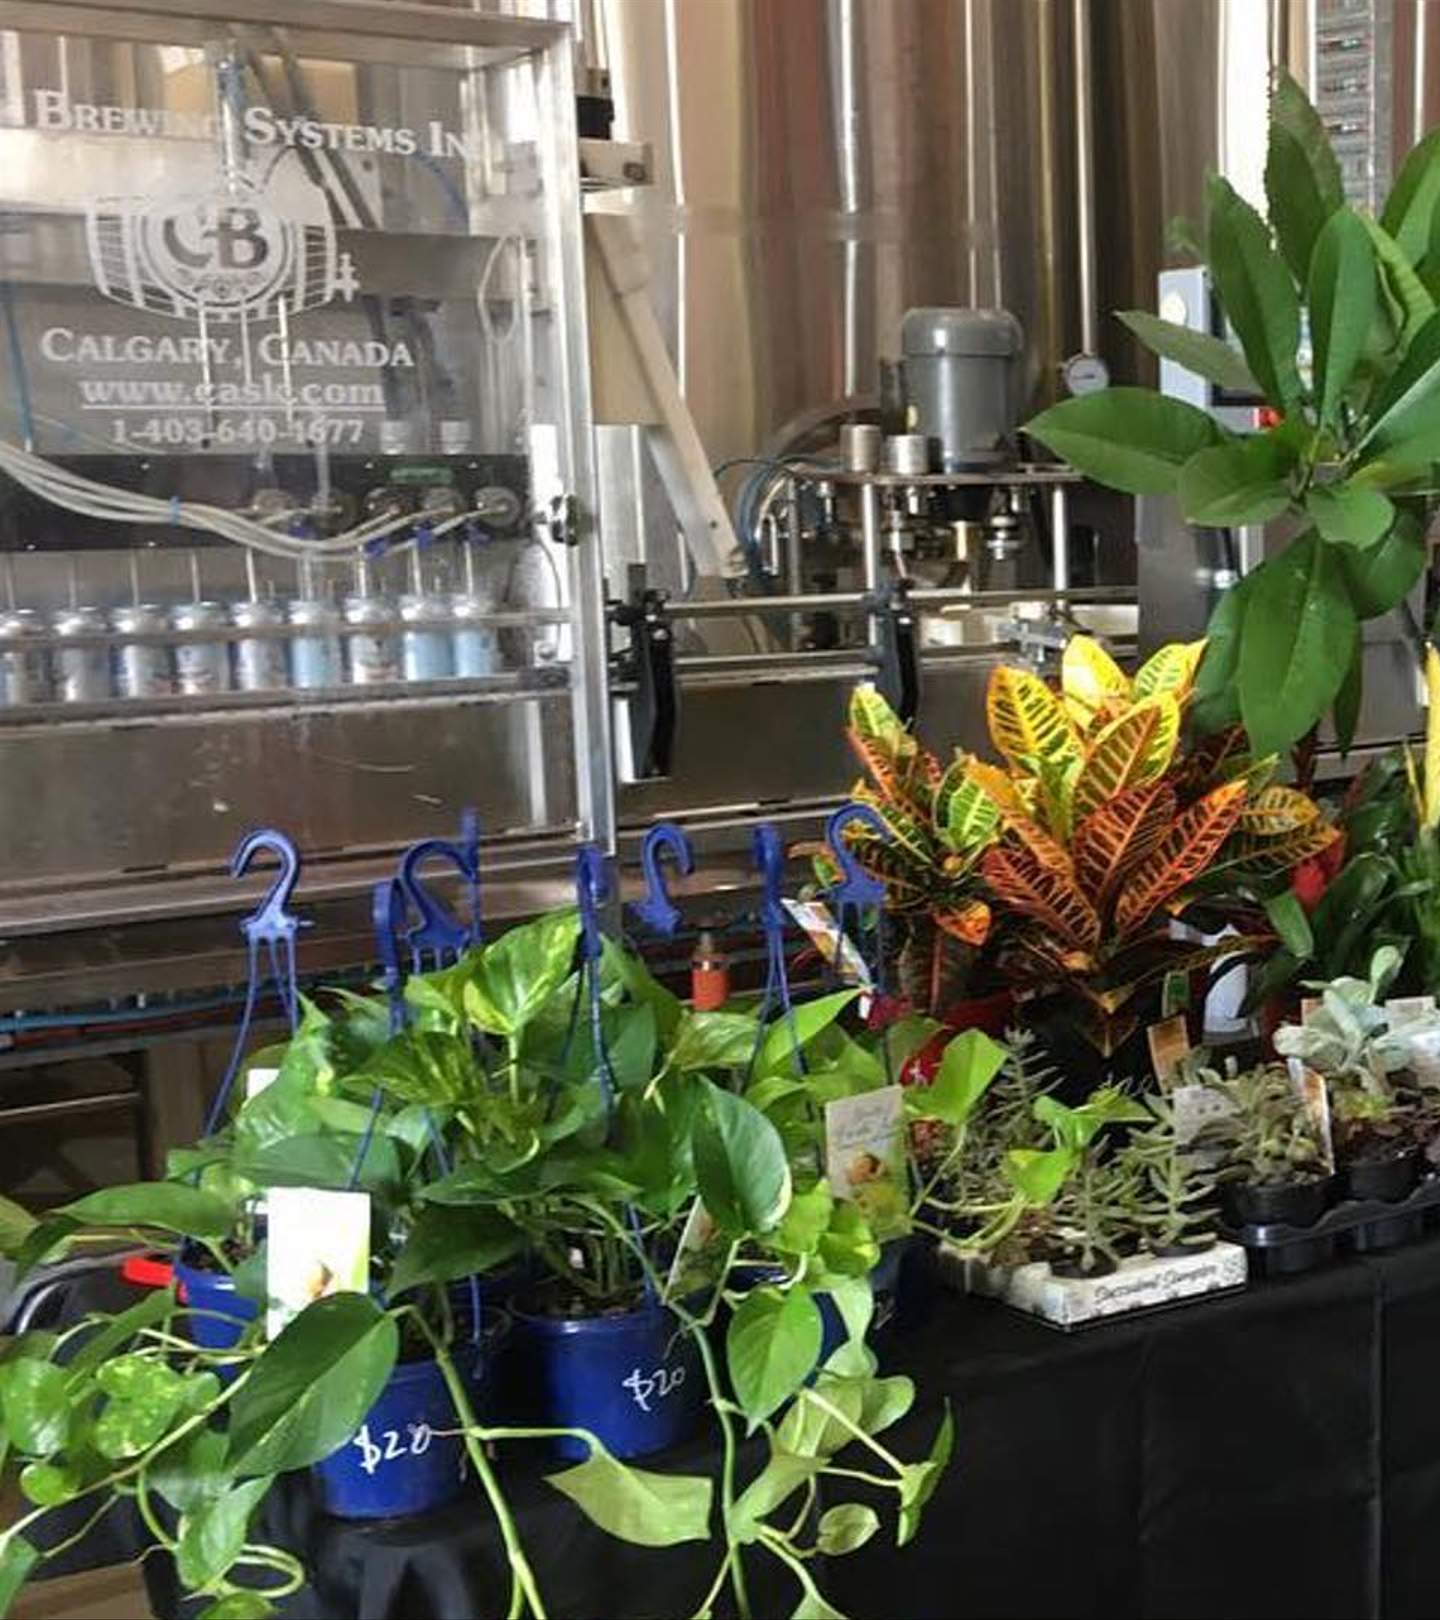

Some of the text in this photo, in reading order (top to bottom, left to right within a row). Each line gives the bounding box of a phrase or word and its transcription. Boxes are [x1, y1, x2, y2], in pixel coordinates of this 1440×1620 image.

[244, 106, 416, 156] SYSTEMS
[429, 121, 474, 157] IN
[41, 327, 415, 370] CALGARY, CANADA
[622, 1366, 687, 1412] $20
[354, 1423, 431, 1475] $20
